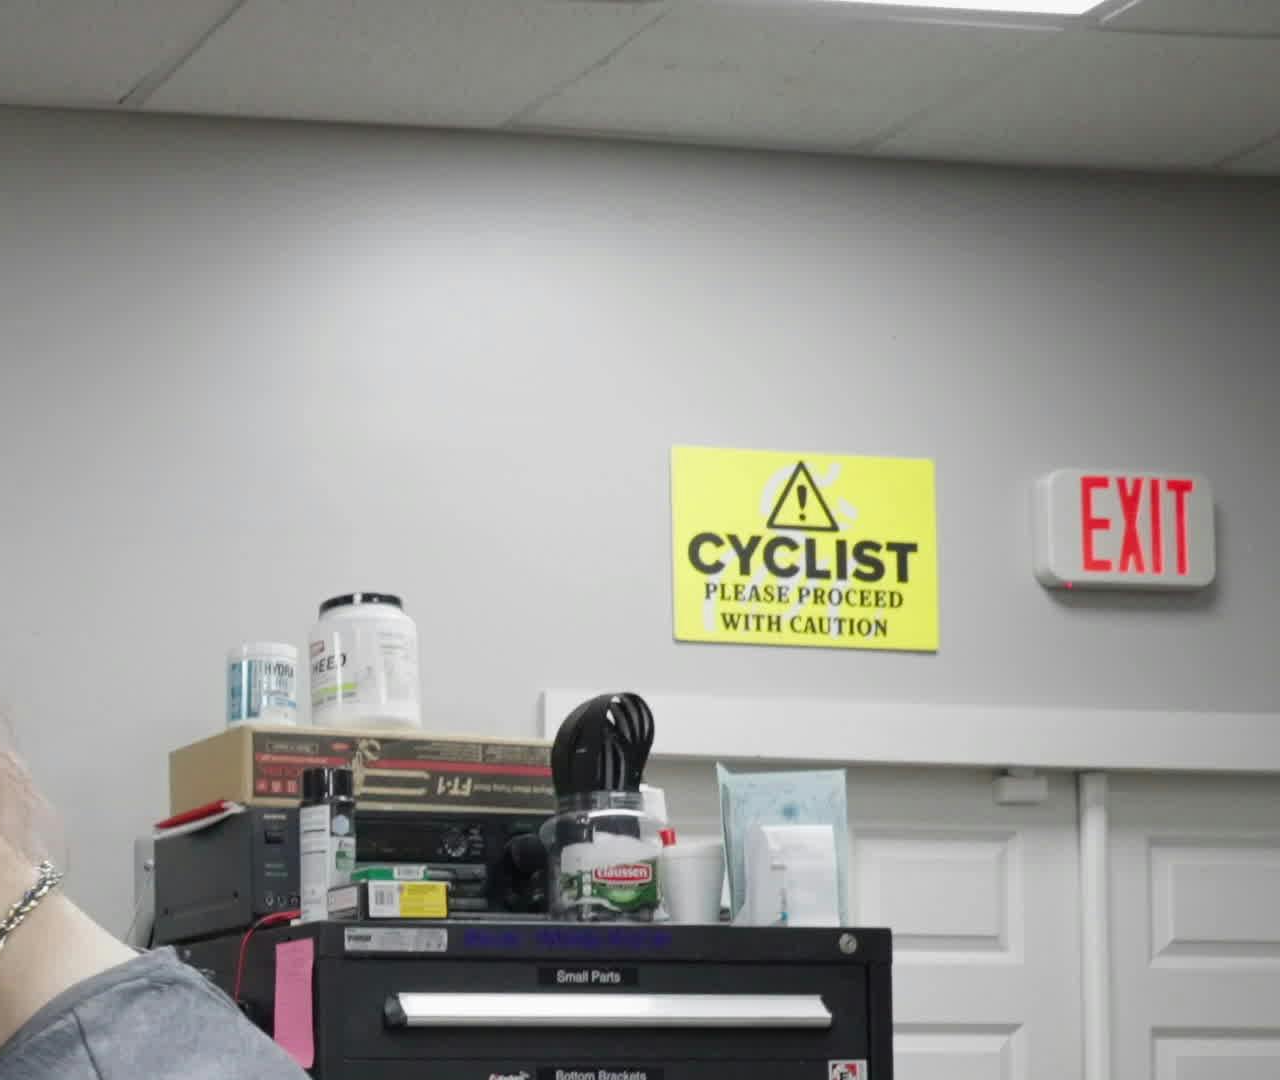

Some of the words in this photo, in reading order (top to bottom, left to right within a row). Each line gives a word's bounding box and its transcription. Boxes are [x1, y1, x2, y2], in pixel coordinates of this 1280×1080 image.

[1080, 475, 1194, 576] EXIT
[687, 532, 919, 583] CYCLIST
[704, 582, 791, 604] PLEASE
[798, 587, 904, 609] PROCEED
[720, 612, 782, 633] WITH
[790, 615, 889, 638] CAUTION
[556, 969, 587, 984] Small
[590, 969, 621, 984] Parts
